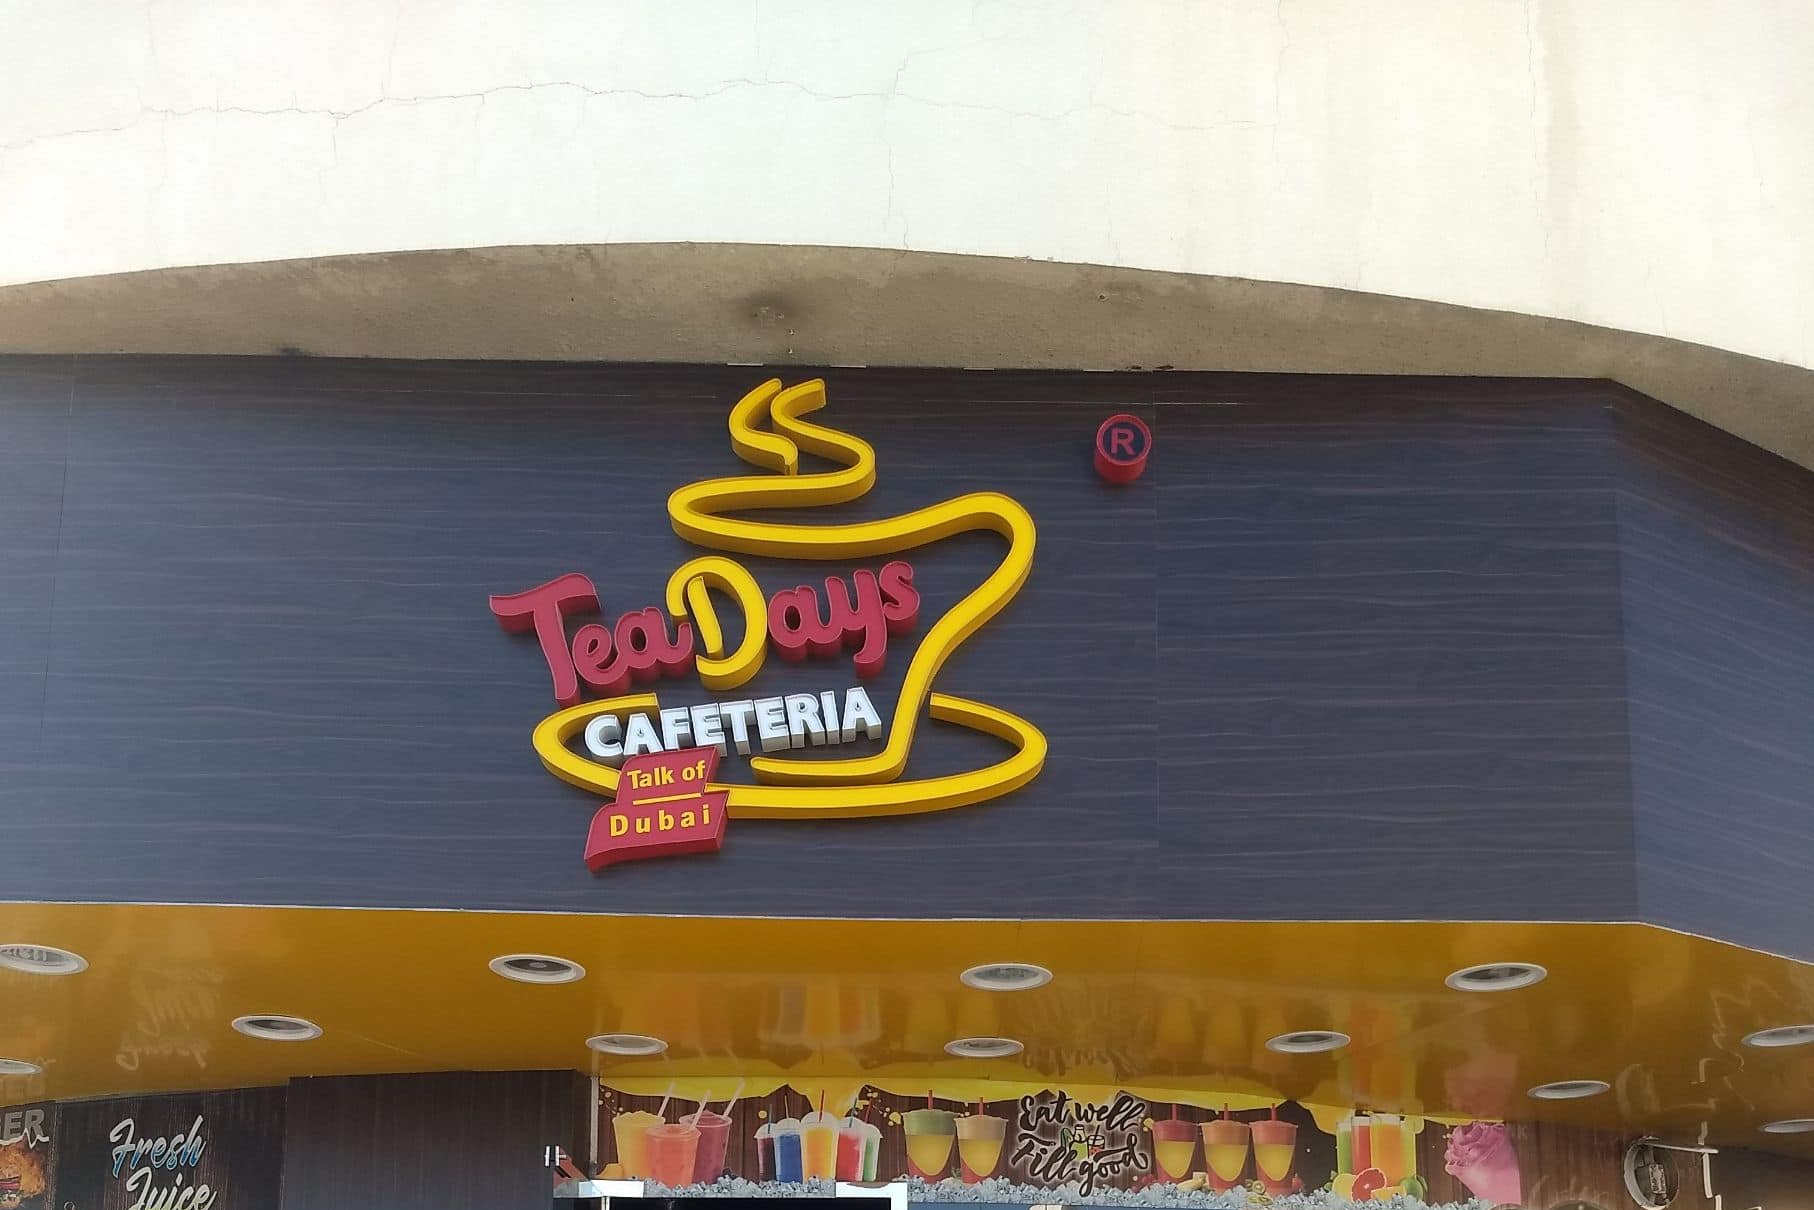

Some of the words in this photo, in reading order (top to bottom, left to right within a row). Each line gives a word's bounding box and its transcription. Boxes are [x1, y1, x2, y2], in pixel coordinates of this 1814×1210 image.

[489, 571, 696, 706] Tea
[666, 555, 920, 690] Days
[583, 686, 882, 765] CAFETERIA
[626, 765, 676, 790] Talk
[681, 759, 706, 781] of
[608, 803, 712, 837] Dubai
[0, 1108, 47, 1140] ER
[1019, 1089, 1073, 1131] Eat
[1074, 1095, 1146, 1131] well
[109, 1114, 207, 1178] Fresh
[1078, 1132, 1149, 1198] good
